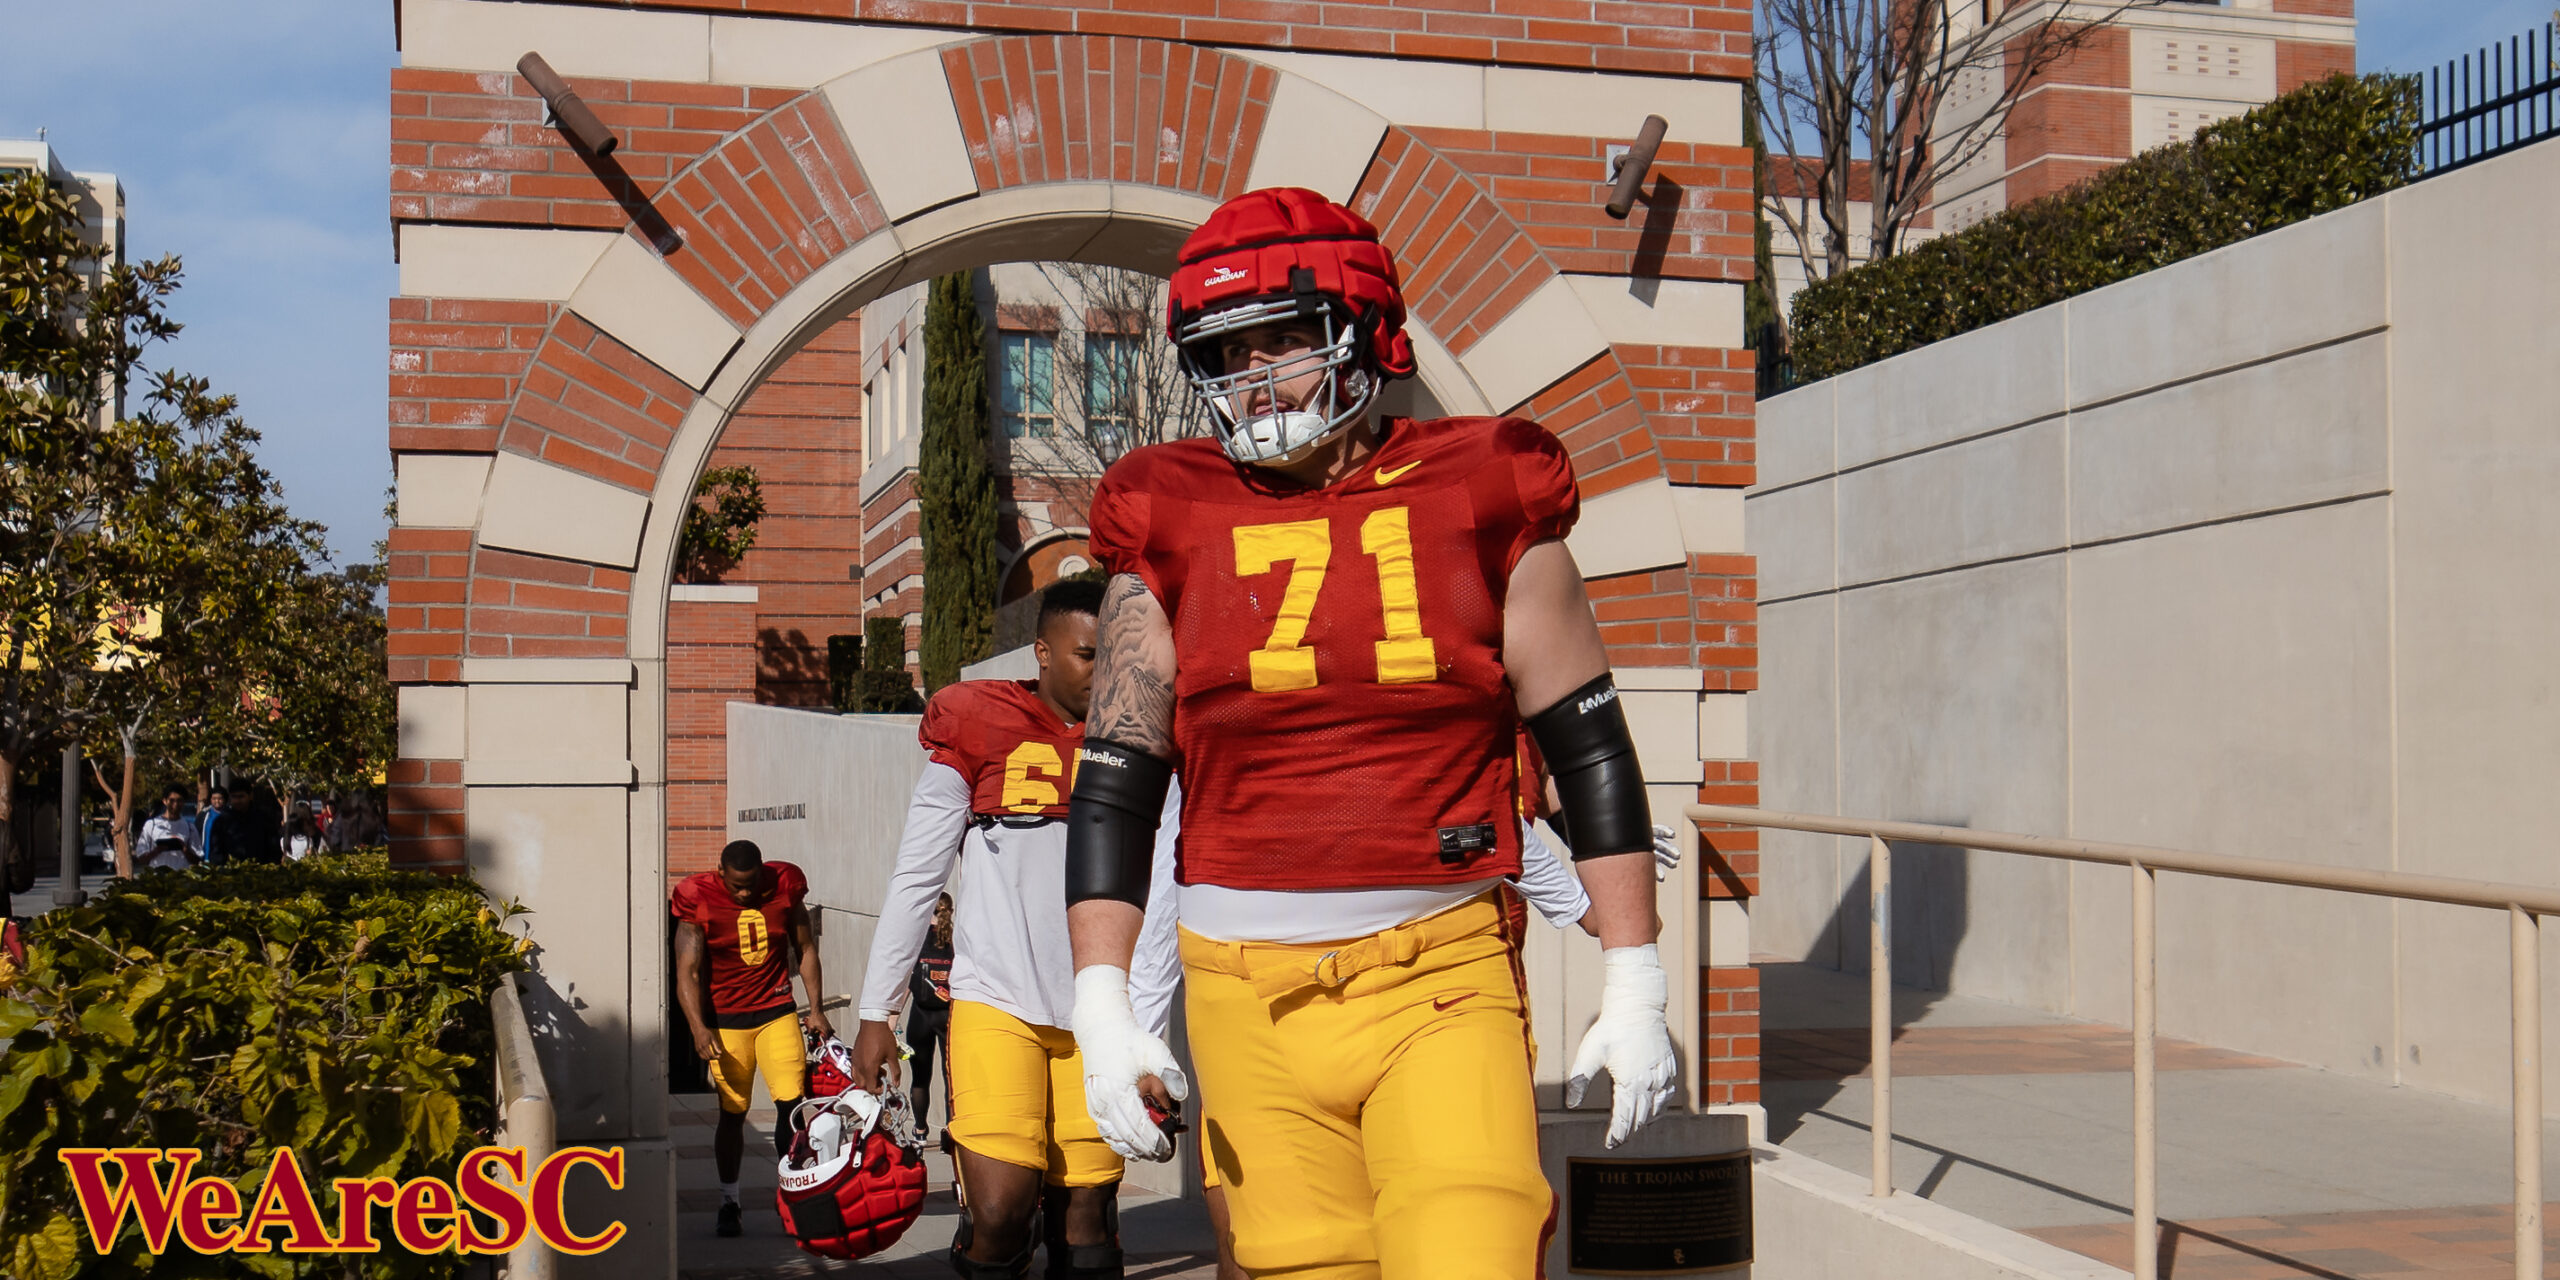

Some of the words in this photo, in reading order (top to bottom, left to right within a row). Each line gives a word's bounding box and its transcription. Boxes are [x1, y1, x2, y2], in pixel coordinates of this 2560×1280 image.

[1204, 269, 1246, 287] GUARDIAN
[1232, 506, 1437, 692] 71
[1001, 741, 1082, 814] 6
[737, 909, 769, 965] 0
[1599, 1171, 1629, 1185] THE
[1632, 1169, 1695, 1187] TROJAN
[1698, 1166, 1739, 1182] SWORD
